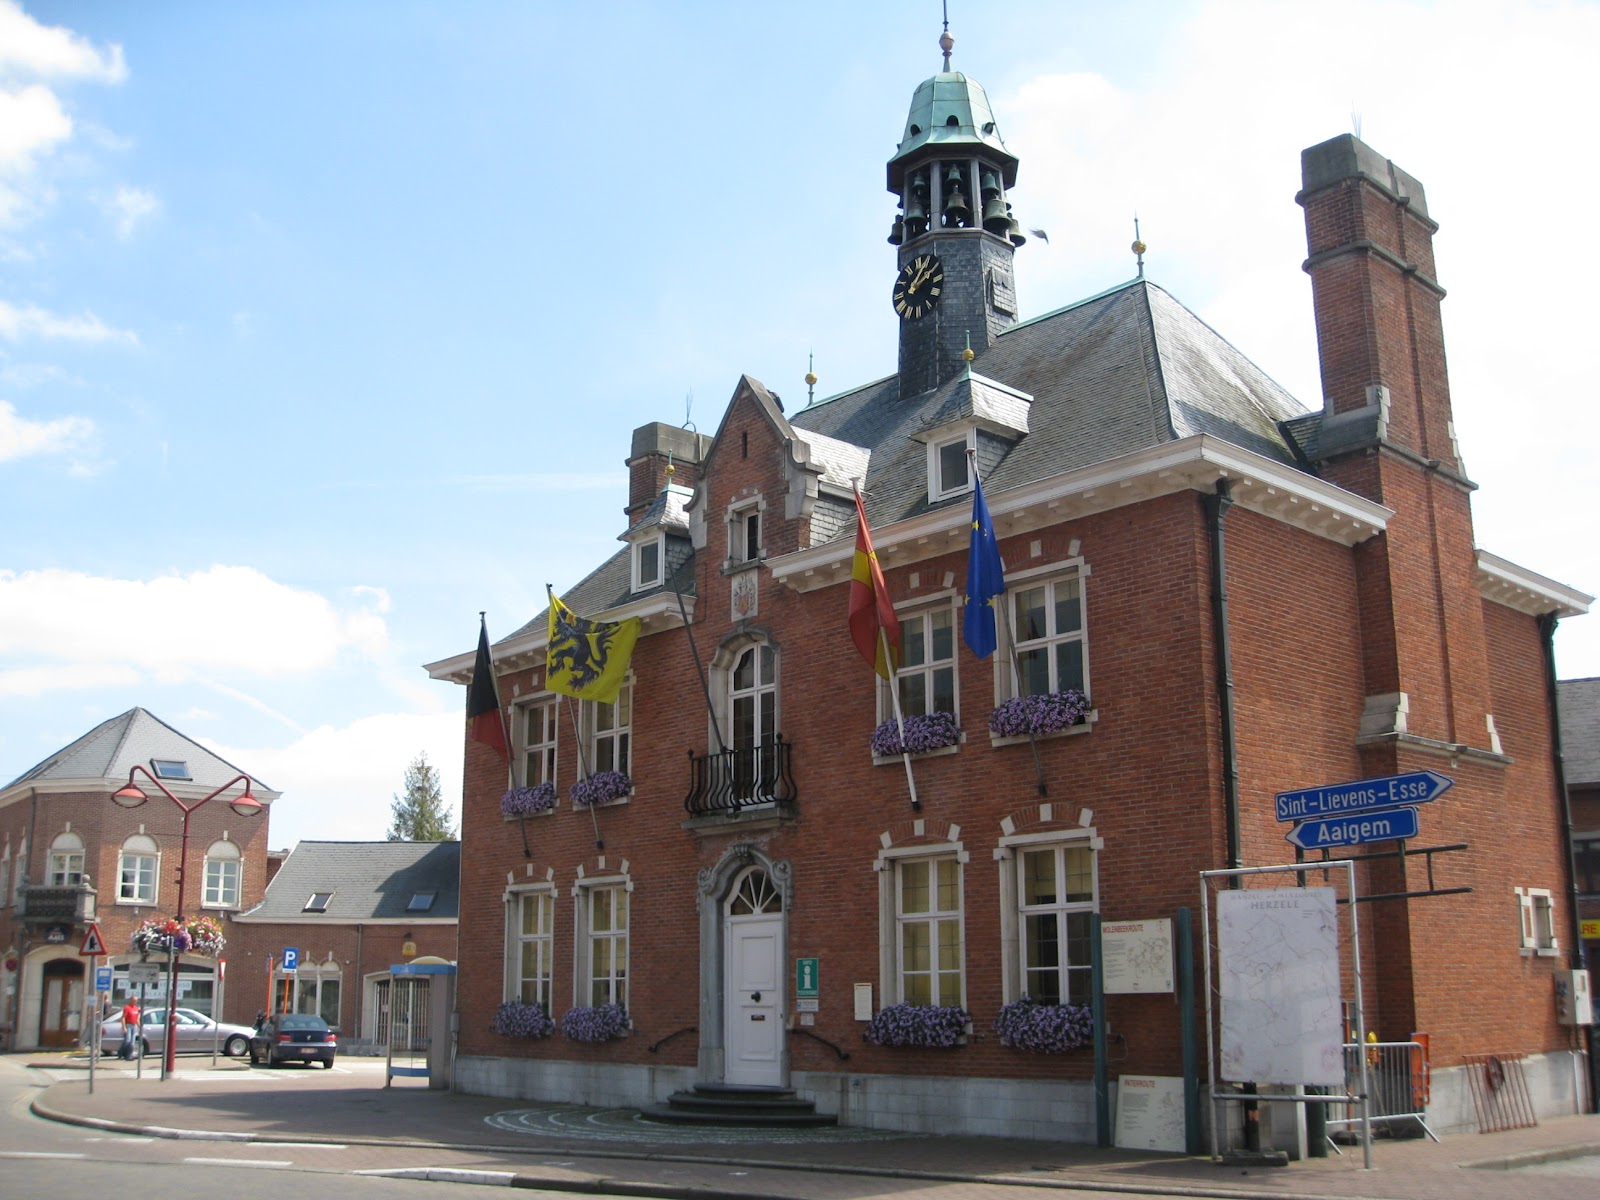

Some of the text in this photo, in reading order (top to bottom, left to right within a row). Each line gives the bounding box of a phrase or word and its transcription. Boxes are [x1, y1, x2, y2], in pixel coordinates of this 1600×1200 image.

[1278, 780, 1428, 816] Sint-Lievens-Esse
[1317, 819, 1391, 844] Aaigem
[1251, 901, 1300, 910] HERZELE
[1103, 924, 1144, 934] MOLENBEEKROUTE
[1581, 923, 1597, 934] RE
[285, 951, 295, 966] P
[1124, 1079, 1156, 1088] PATERROUTE
